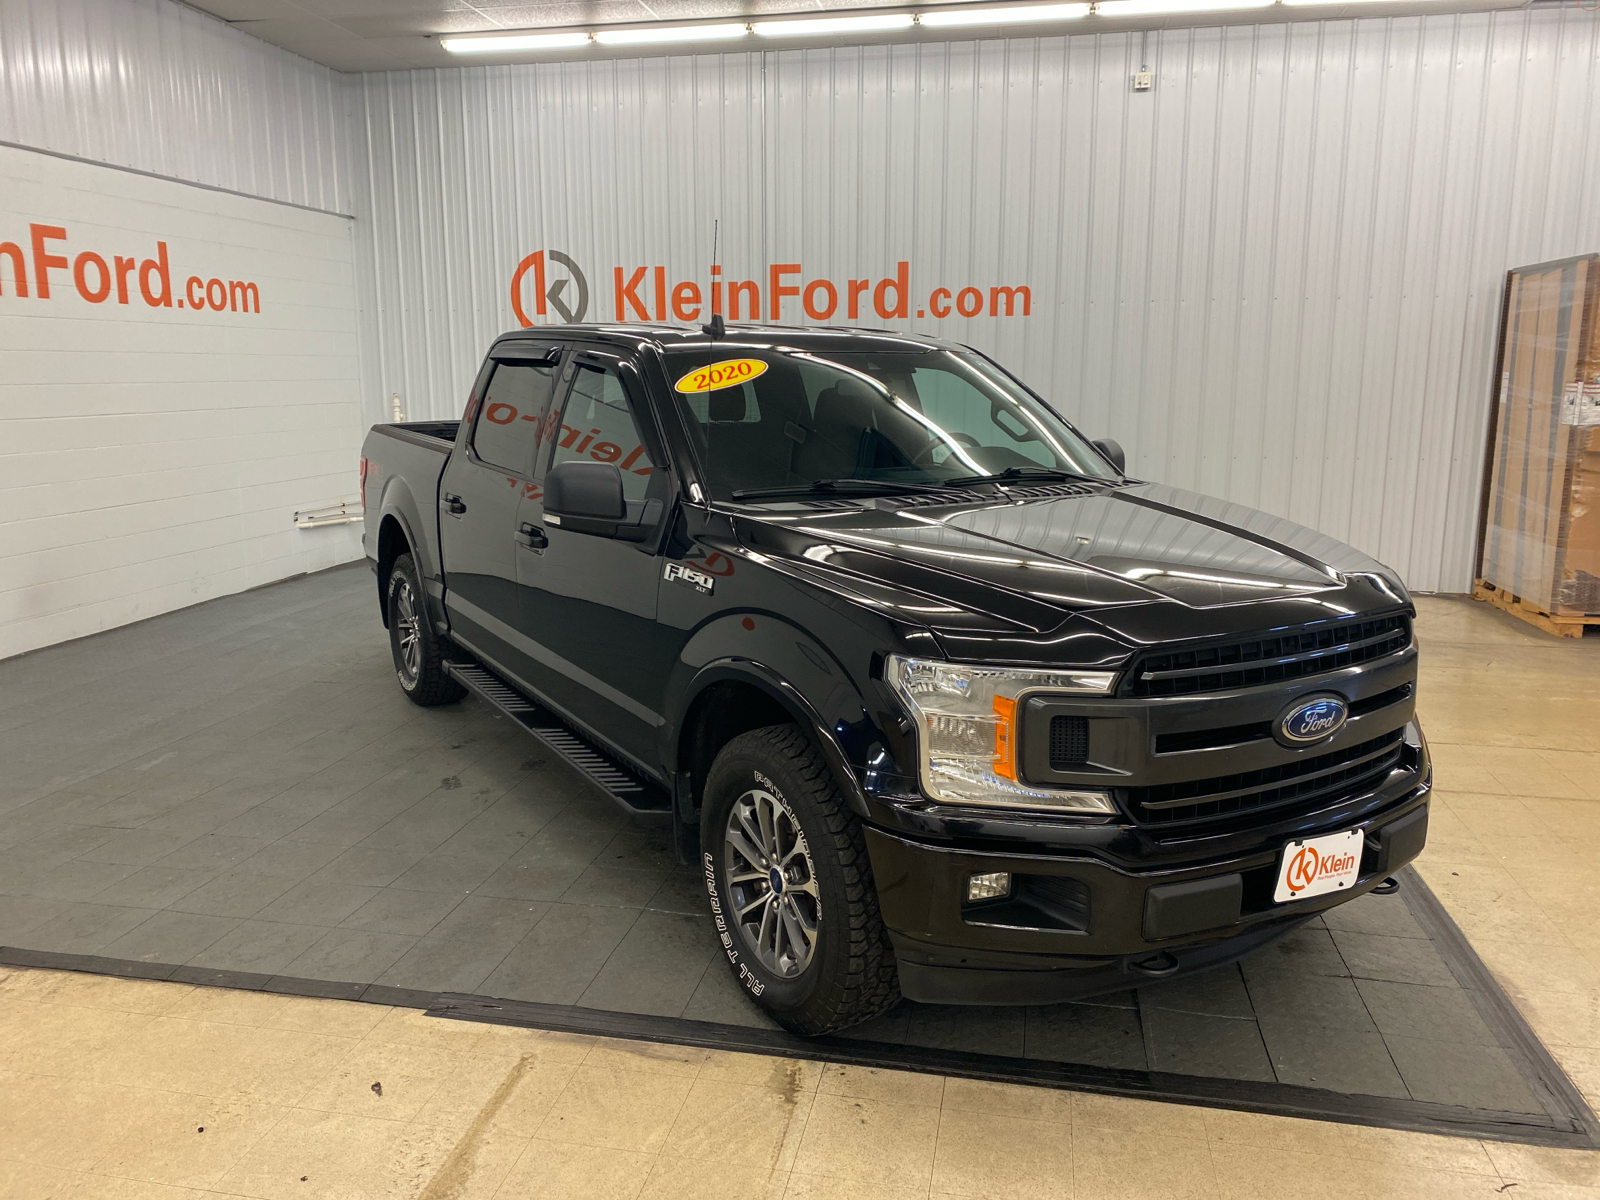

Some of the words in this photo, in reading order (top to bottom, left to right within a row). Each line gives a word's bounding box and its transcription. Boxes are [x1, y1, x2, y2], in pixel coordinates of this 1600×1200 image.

[613, 261, 1032, 322] KleinFord.com
[693, 362, 752, 390] 2020
[694, 585, 707, 593] XLT
[1300, 705, 1336, 734] Ford
[1318, 851, 1355, 875] Klein
[704, 852, 739, 964] TERRAIN
[740, 963, 765, 997] ALL
